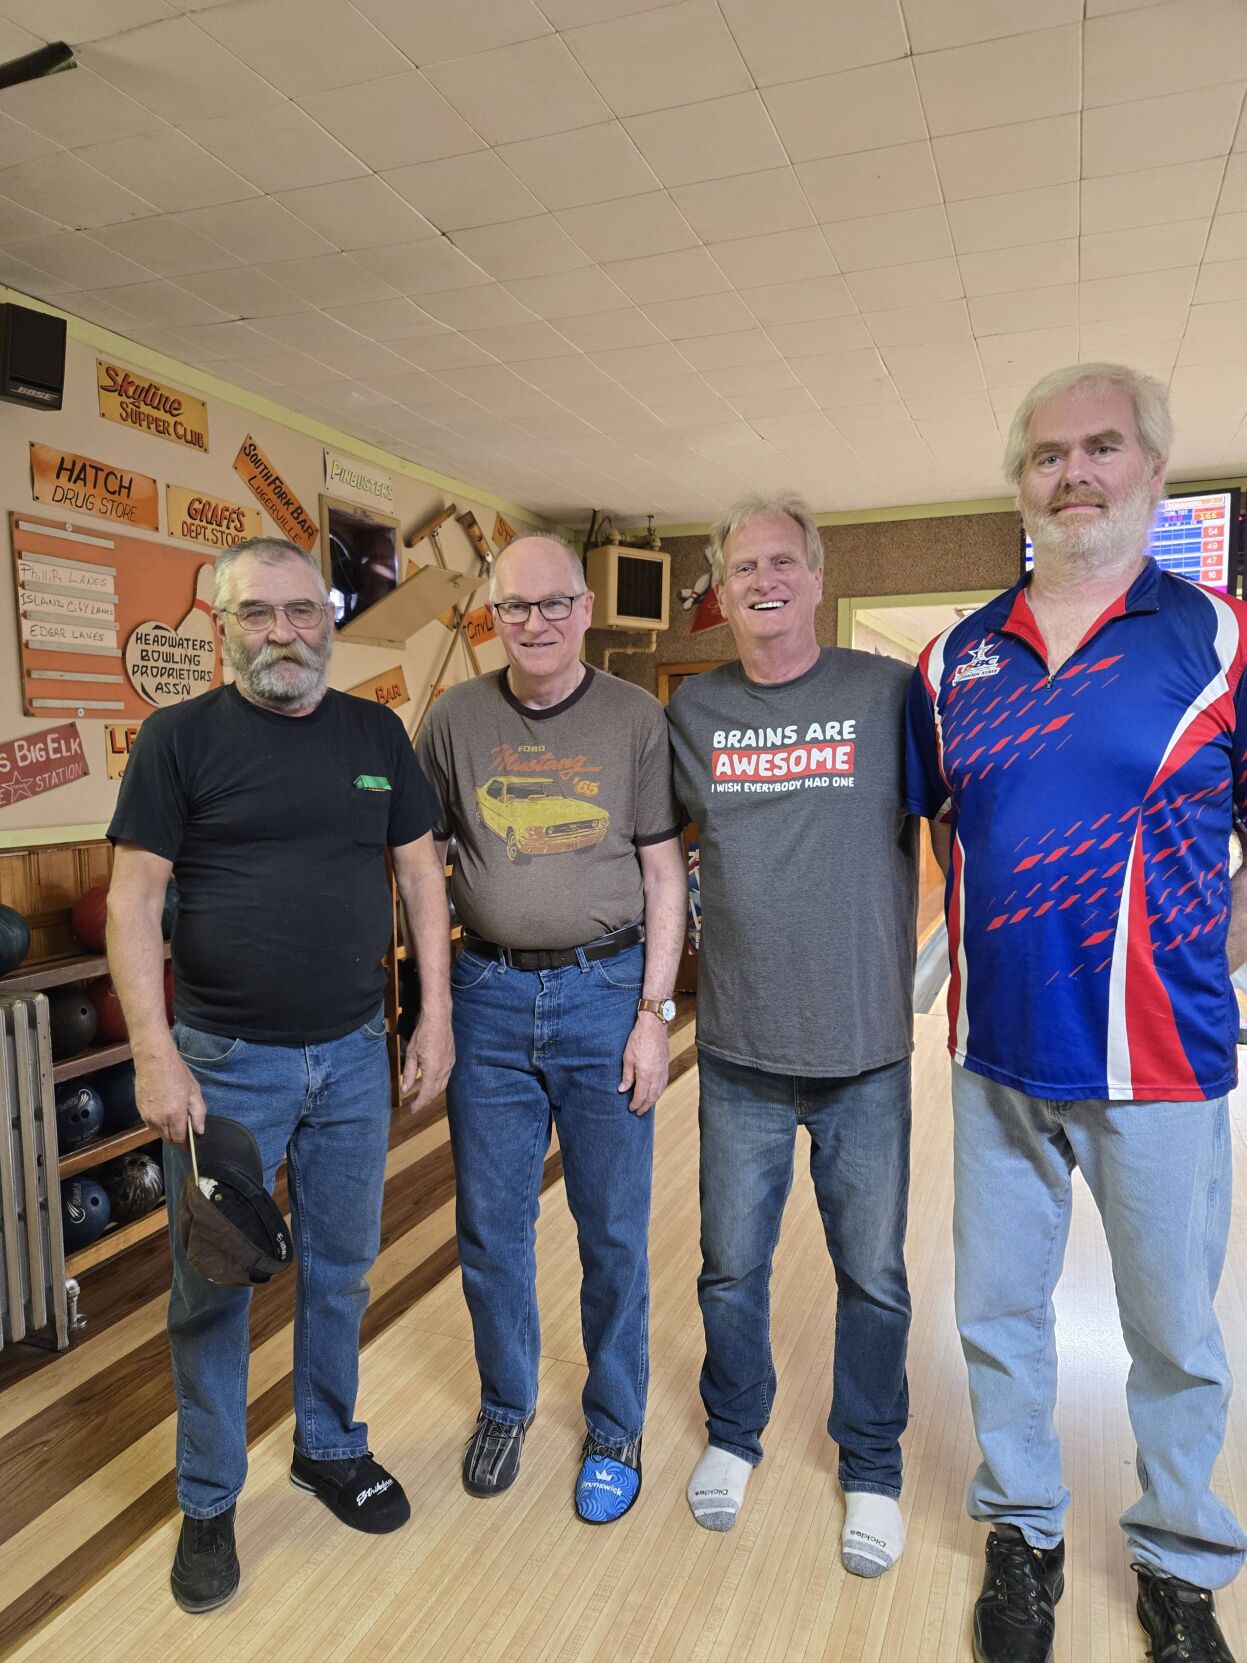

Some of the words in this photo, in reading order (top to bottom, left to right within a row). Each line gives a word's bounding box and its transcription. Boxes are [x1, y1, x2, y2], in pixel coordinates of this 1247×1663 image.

[12, 386, 58, 400] BOSE
[100, 366, 184, 417] Skyline
[119, 401, 171, 437] SUPPER
[173, 420, 205, 449] CLUB
[56, 456, 133, 498] HATCH
[243, 443, 273, 482] SOUTH
[267, 475, 295, 511] FORK
[289, 506, 314, 540] BAR
[331, 460, 393, 501] PINBUSTERS
[52, 485, 94, 511] DRUG
[99, 496, 137, 522] STORE
[187, 497, 246, 533] GRAFF'S
[181, 520, 210, 542] DEPT.
[210, 528, 248, 548] STOR
[1207, 527, 1218, 536] 54
[1206, 556, 1217, 565] 47
[69, 570, 108, 587] LANES
[30, 624, 67, 638] EDGAR
[72, 629, 104, 641] LANES
[135, 632, 214, 653] HEADWATERS
[140, 649, 201, 667] BOWLING
[132, 664, 213, 682] PROPRIETORS
[375, 685, 402, 704] BAR
[713, 725, 798, 748] BRAINS
[805, 719, 856, 741] ARE
[14, 740, 47, 767] BIG
[47, 733, 81, 760] ELK
[489, 744, 602, 779] Mustang
[715, 746, 851, 777] AWESOME
[35, 762, 83, 791] STATION
[711, 783, 715, 793] I
[716, 782, 742, 792] WISH
[744, 779, 802, 793] EVERYBODY
[804, 777, 830, 788] HAD
[832, 777, 855, 787] ONE
